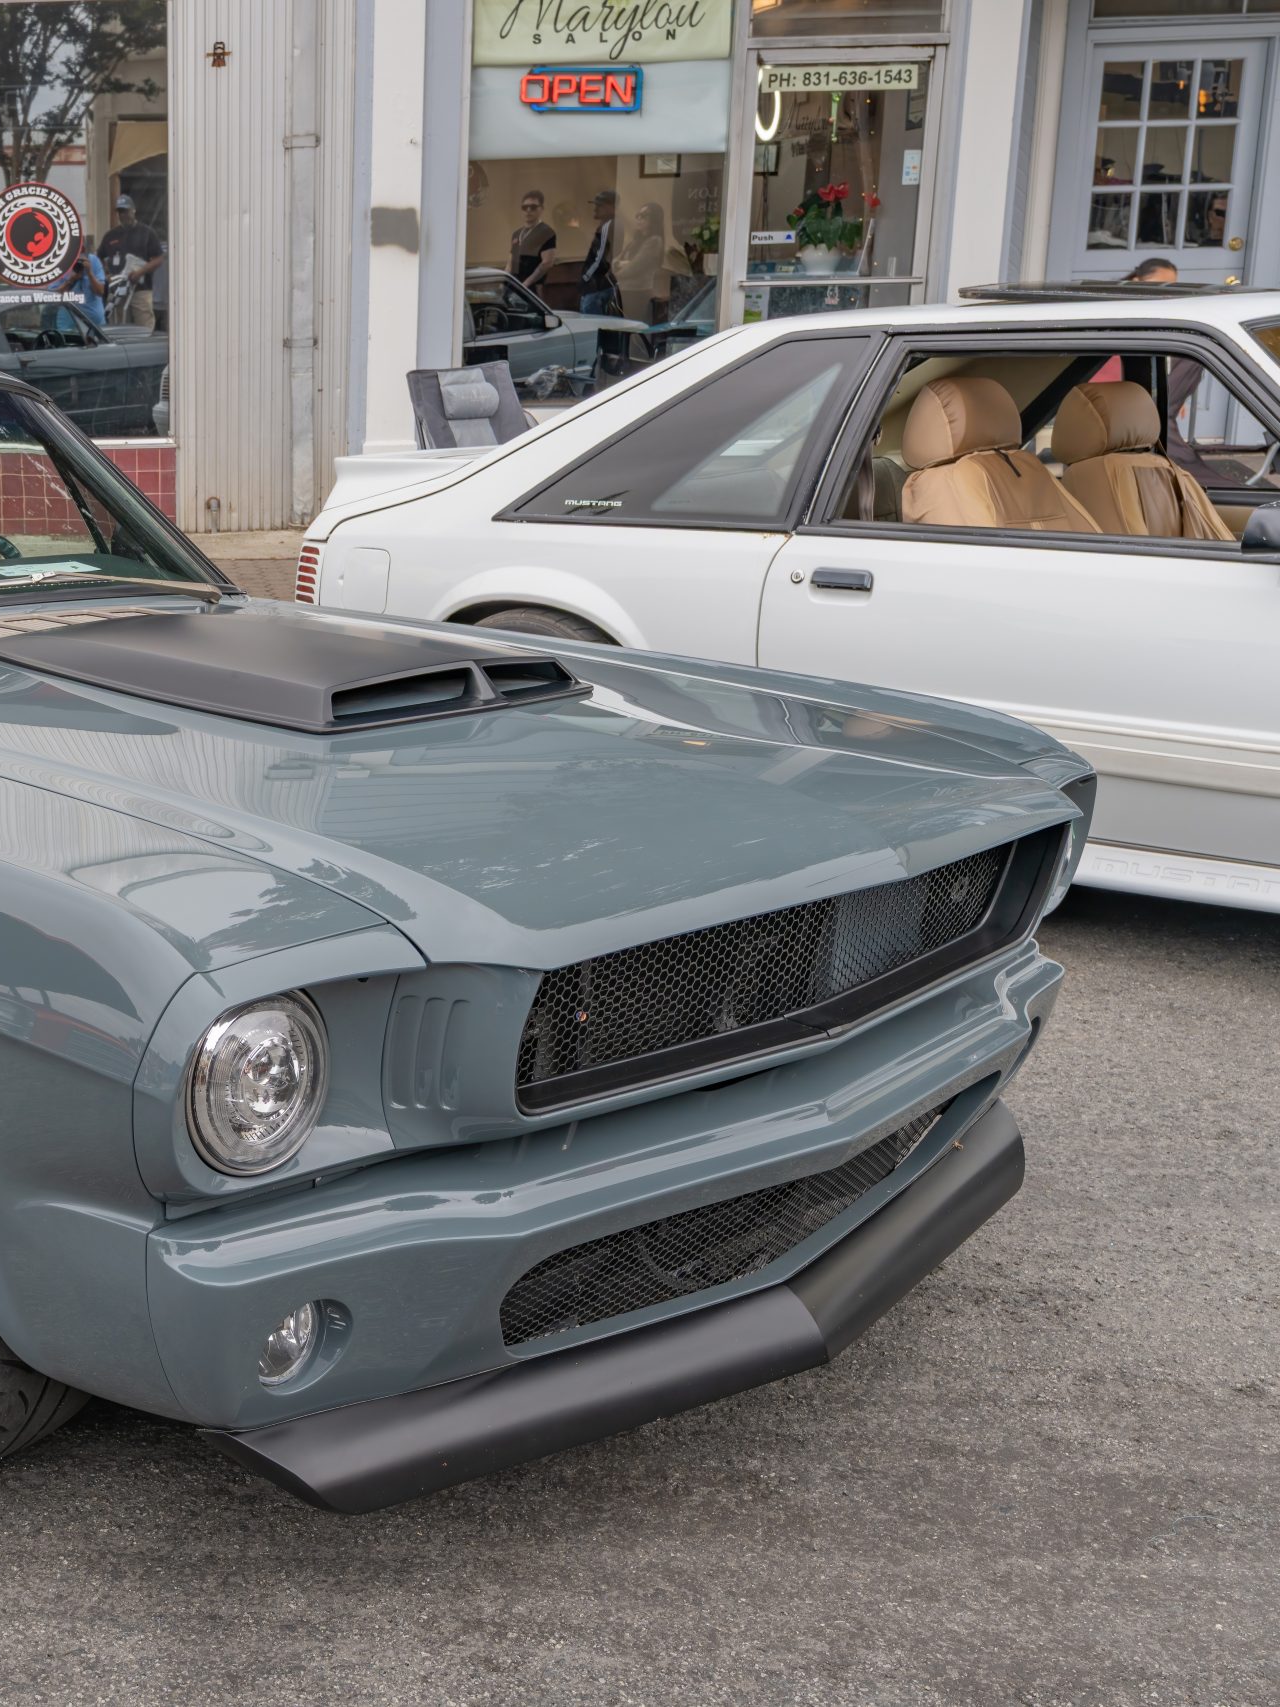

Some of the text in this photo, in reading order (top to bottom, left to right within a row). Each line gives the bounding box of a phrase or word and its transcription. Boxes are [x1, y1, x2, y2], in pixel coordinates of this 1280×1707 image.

[500, 0, 705, 60] Marylou
[532, 29, 677, 45] SALON
[768, 69, 913, 89] PH: 831-636-1543
[520, 75, 632, 104] OPEN
[5, 186, 49, 201] GRACIE
[48, 191, 80, 237] JIU-JITSU
[2, 267, 62, 285] HOLLISTER
[21, 295, 32, 303] on
[63, 291, 85, 304] Alley
[564, 499, 623, 507] MUSTANG
